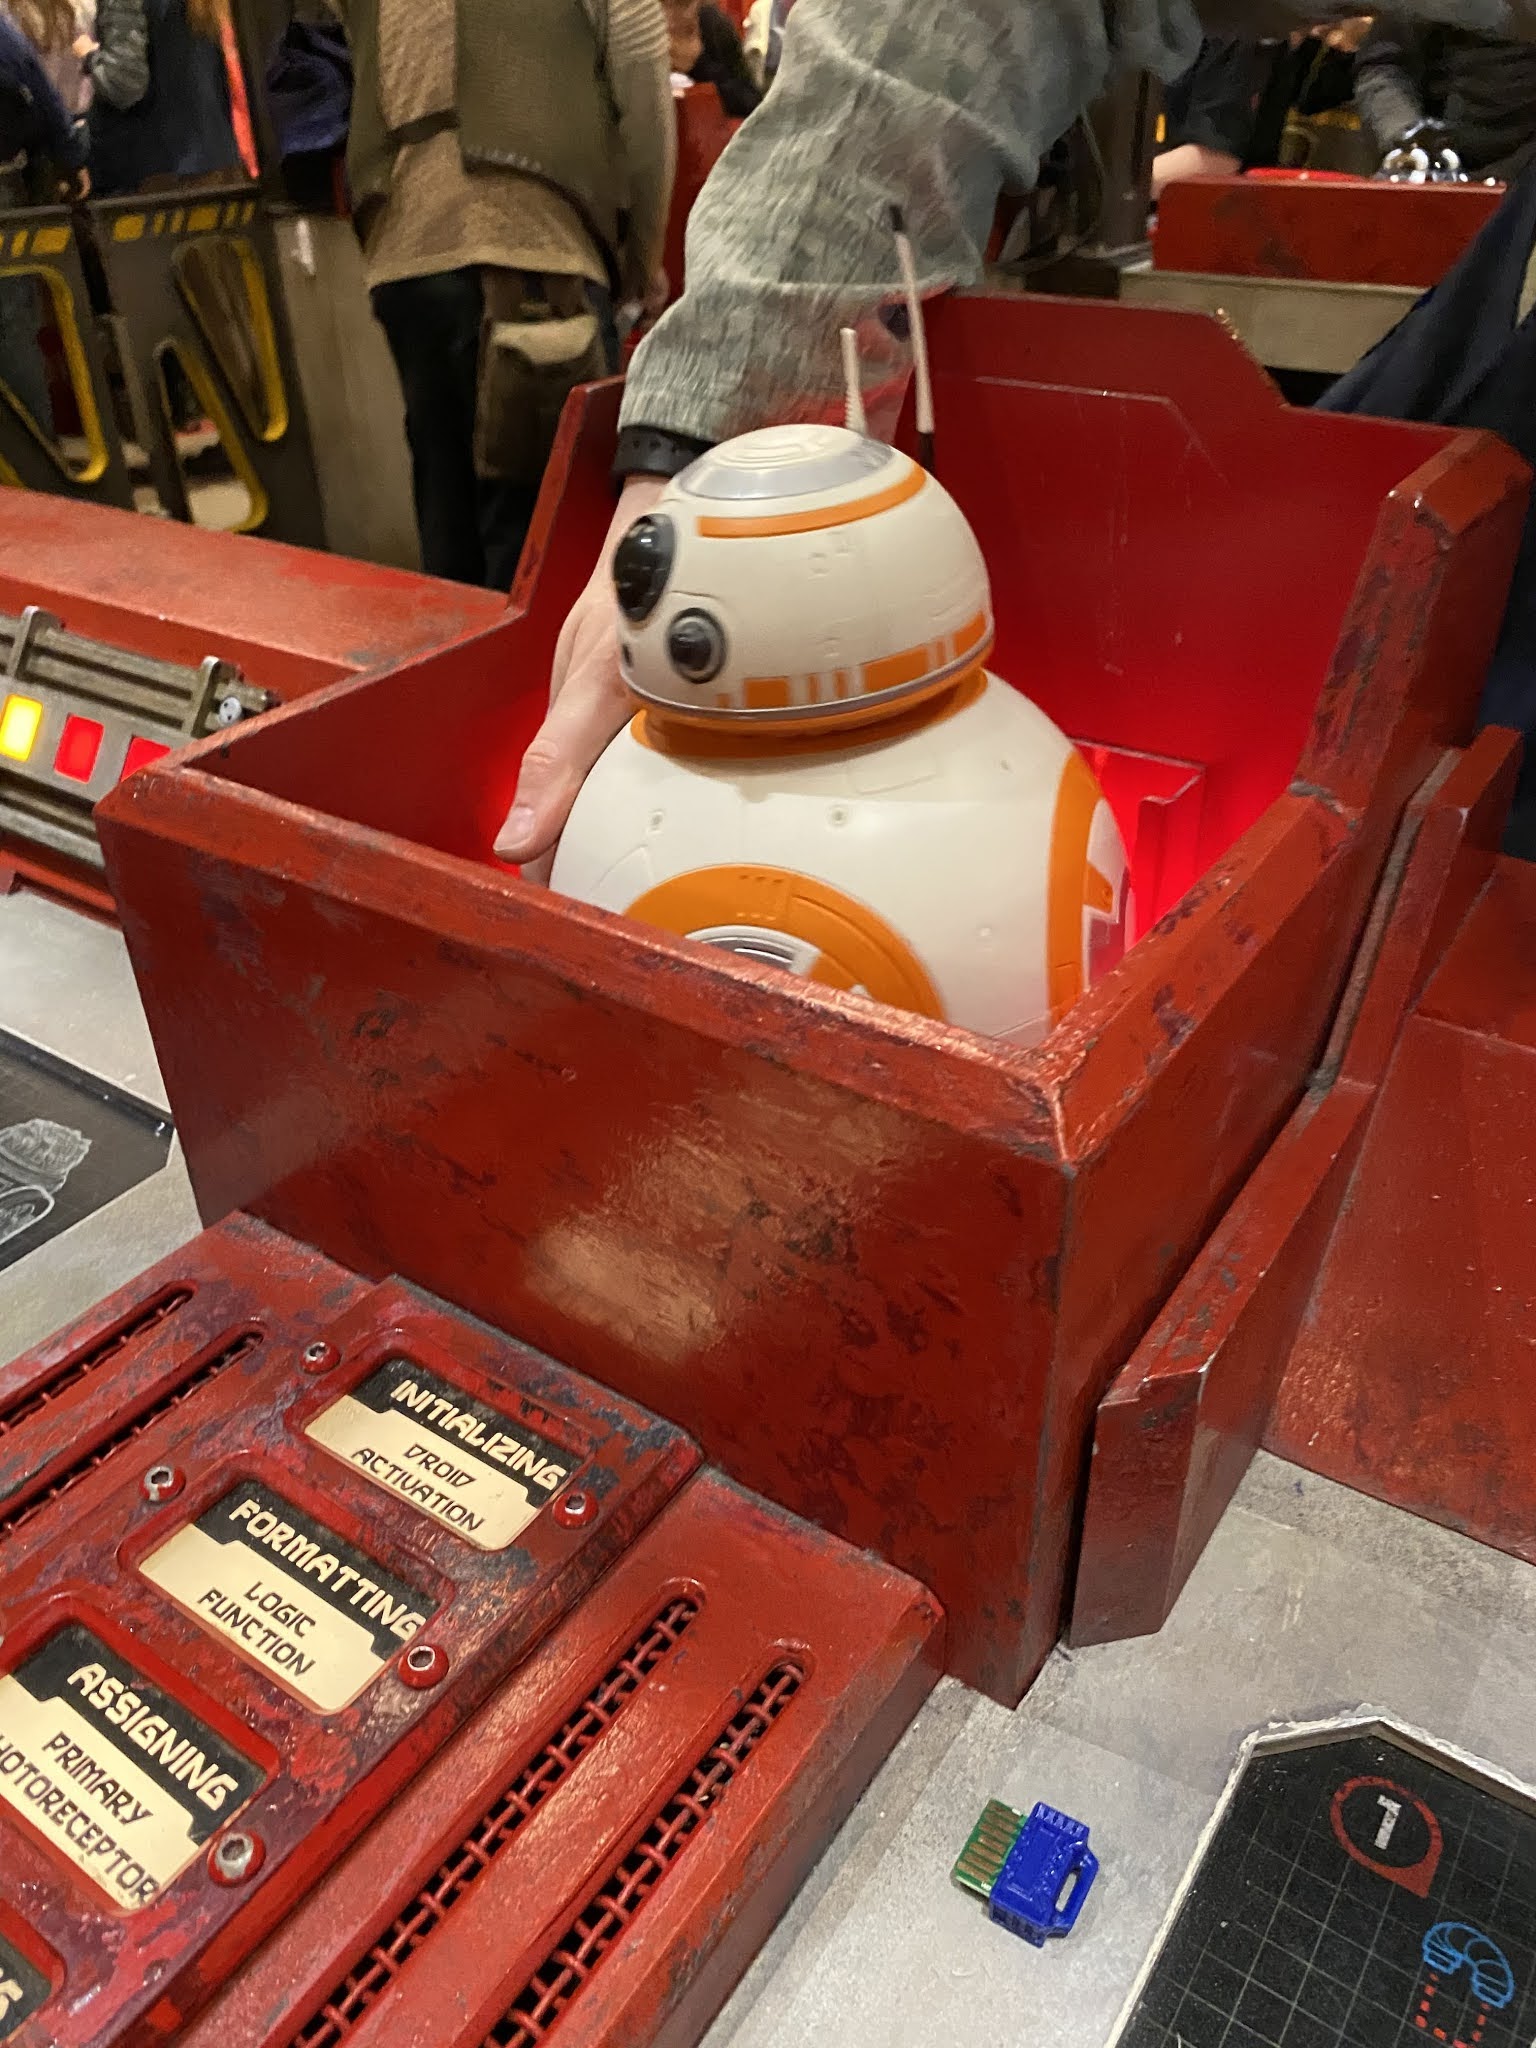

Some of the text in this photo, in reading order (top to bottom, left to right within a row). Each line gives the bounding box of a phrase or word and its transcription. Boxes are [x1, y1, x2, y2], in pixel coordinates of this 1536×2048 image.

[390, 1379, 567, 1491] INITIALIZING
[403, 1443, 477, 1488] DROID
[351, 1448, 485, 1532] ACTIVATION
[229, 1499, 427, 1642] FORMATTING
[243, 1581, 316, 1639] LOGIC
[197, 1587, 316, 1677] FUNCTION
[42, 1731, 153, 1825] PRIMARY
[67, 1662, 239, 1811] ASSIGNING
